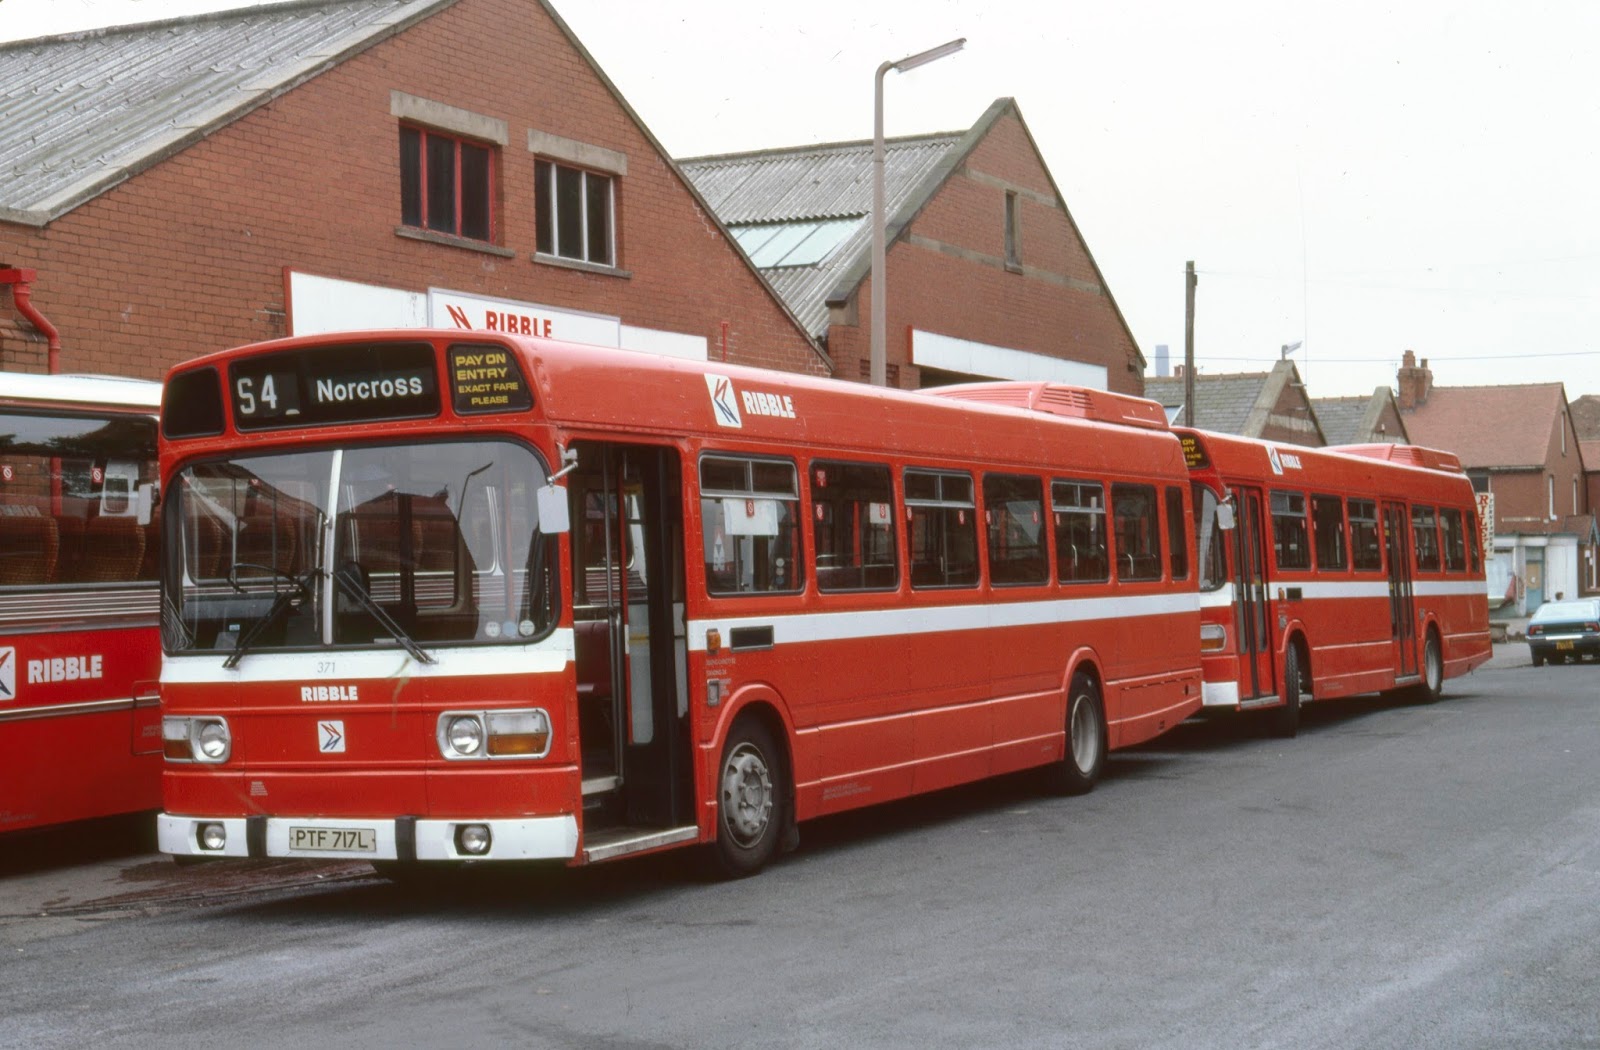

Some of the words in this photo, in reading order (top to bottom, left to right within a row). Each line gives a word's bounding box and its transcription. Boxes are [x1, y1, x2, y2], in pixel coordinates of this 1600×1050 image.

[486, 311, 552, 338] RIBBLE
[455, 355, 483, 367] PAY
[486, 353, 506, 364] ON
[456, 367, 507, 380] ENTRY
[237, 374, 277, 414] S4
[317, 376, 423, 402] Norcross
[458, 383, 491, 393] EXACT
[493, 382, 518, 391] FARE
[471, 396, 508, 405] PLEASE
[741, 390, 796, 418] RIBBLE
[28, 654, 103, 684] RIBBLE
[317, 662, 336, 673] 371
[301, 686, 358, 702] RIBBLE
[296, 830, 327, 847] PTF
[332, 831, 368, 848] 717L
